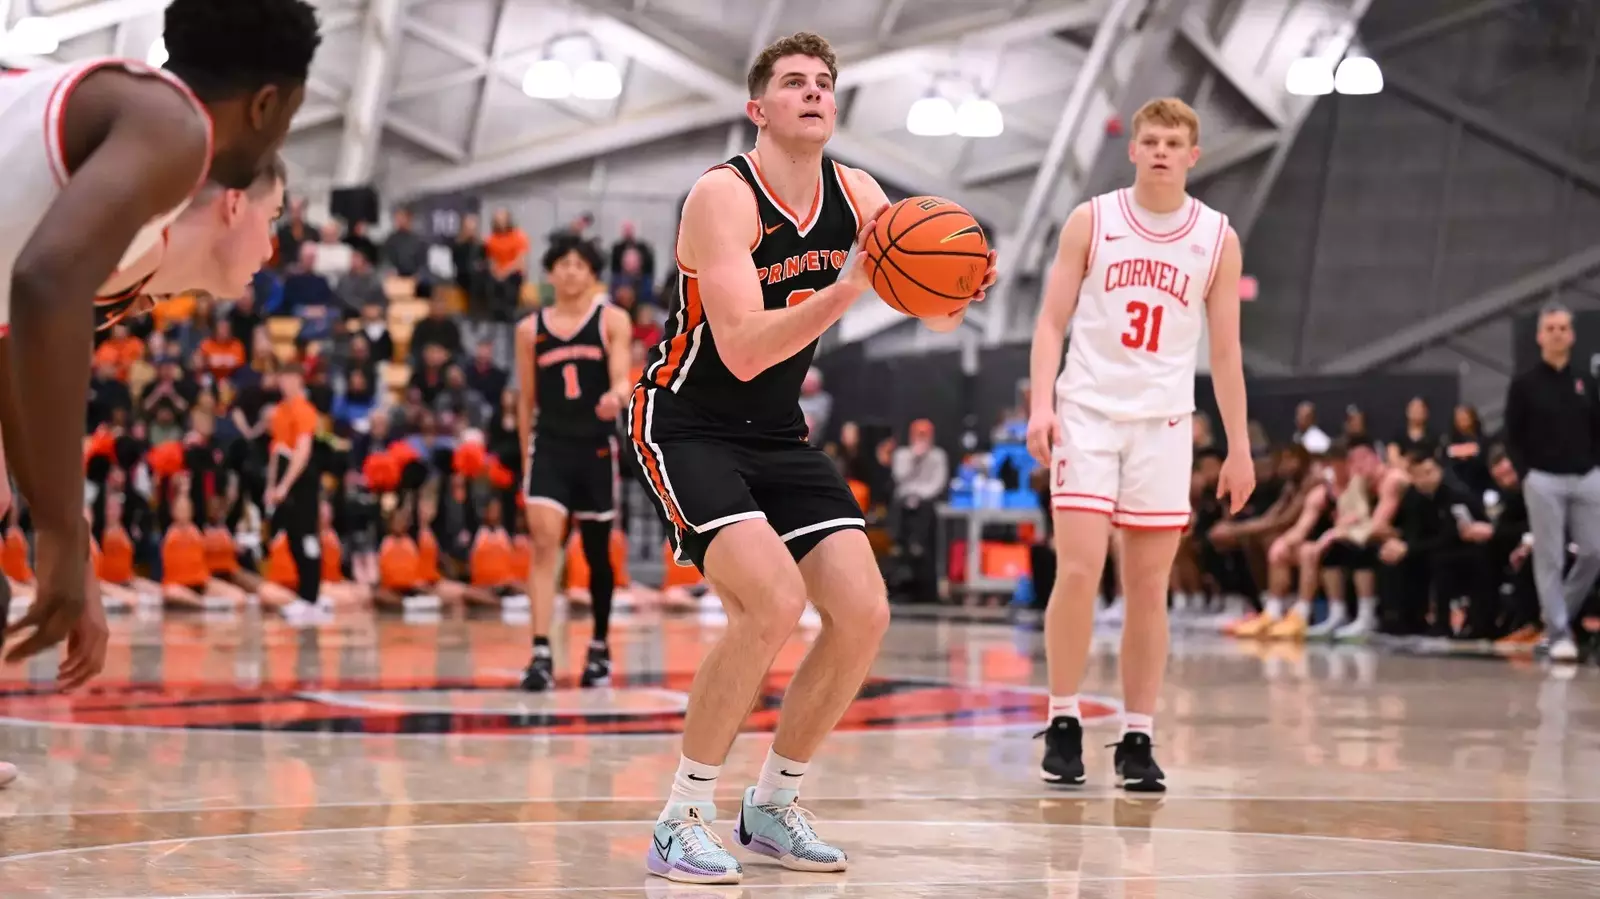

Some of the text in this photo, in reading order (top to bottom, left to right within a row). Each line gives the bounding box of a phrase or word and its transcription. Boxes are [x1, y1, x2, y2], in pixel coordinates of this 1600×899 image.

[1104, 259, 1191, 307] CORNELL
[1121, 300, 1164, 352] 31
[562, 363, 582, 400] 1
[1056, 459, 1067, 488] C
